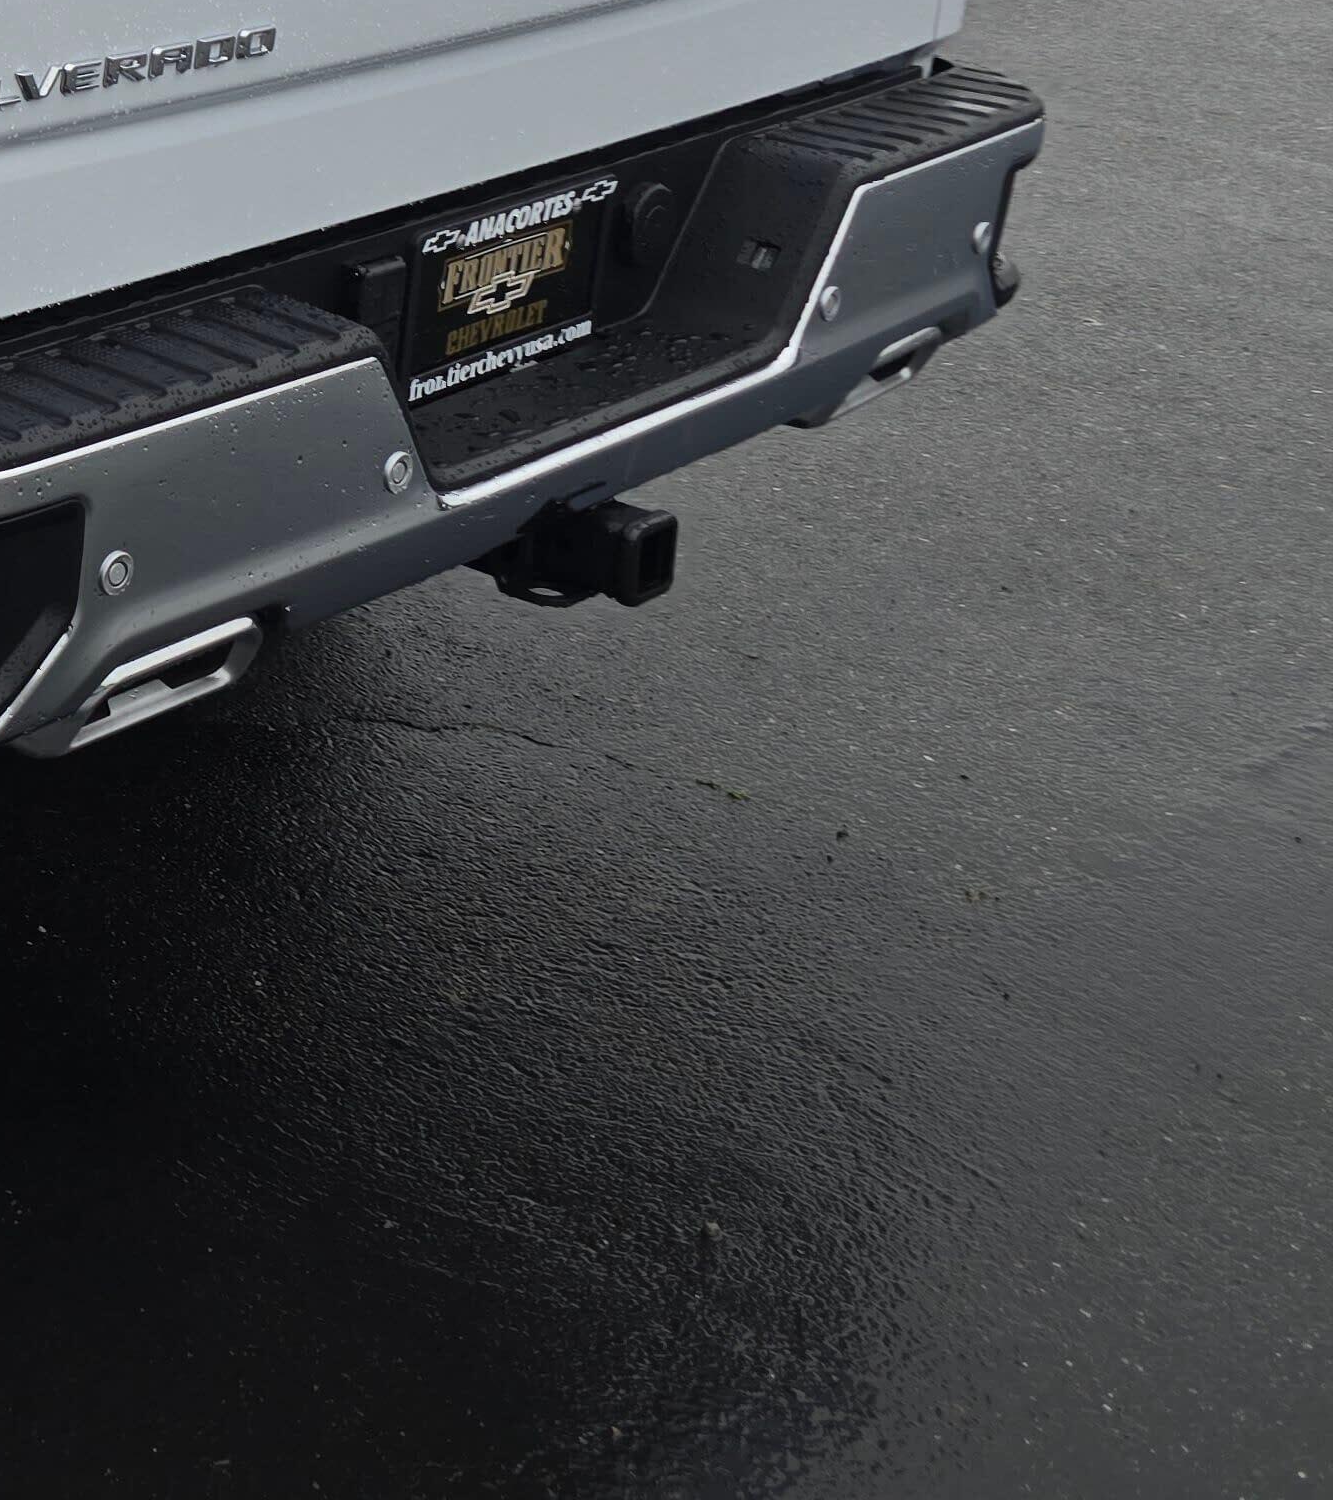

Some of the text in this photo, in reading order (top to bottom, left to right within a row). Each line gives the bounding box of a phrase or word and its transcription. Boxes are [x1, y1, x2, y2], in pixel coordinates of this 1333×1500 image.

[463, 191, 577, 247] ANACORTES
[441, 226, 567, 306] FRONTIER
[407, 319, 593, 402] frontierchevyusa.com
[445, 299, 549, 357] CHEVROLET
